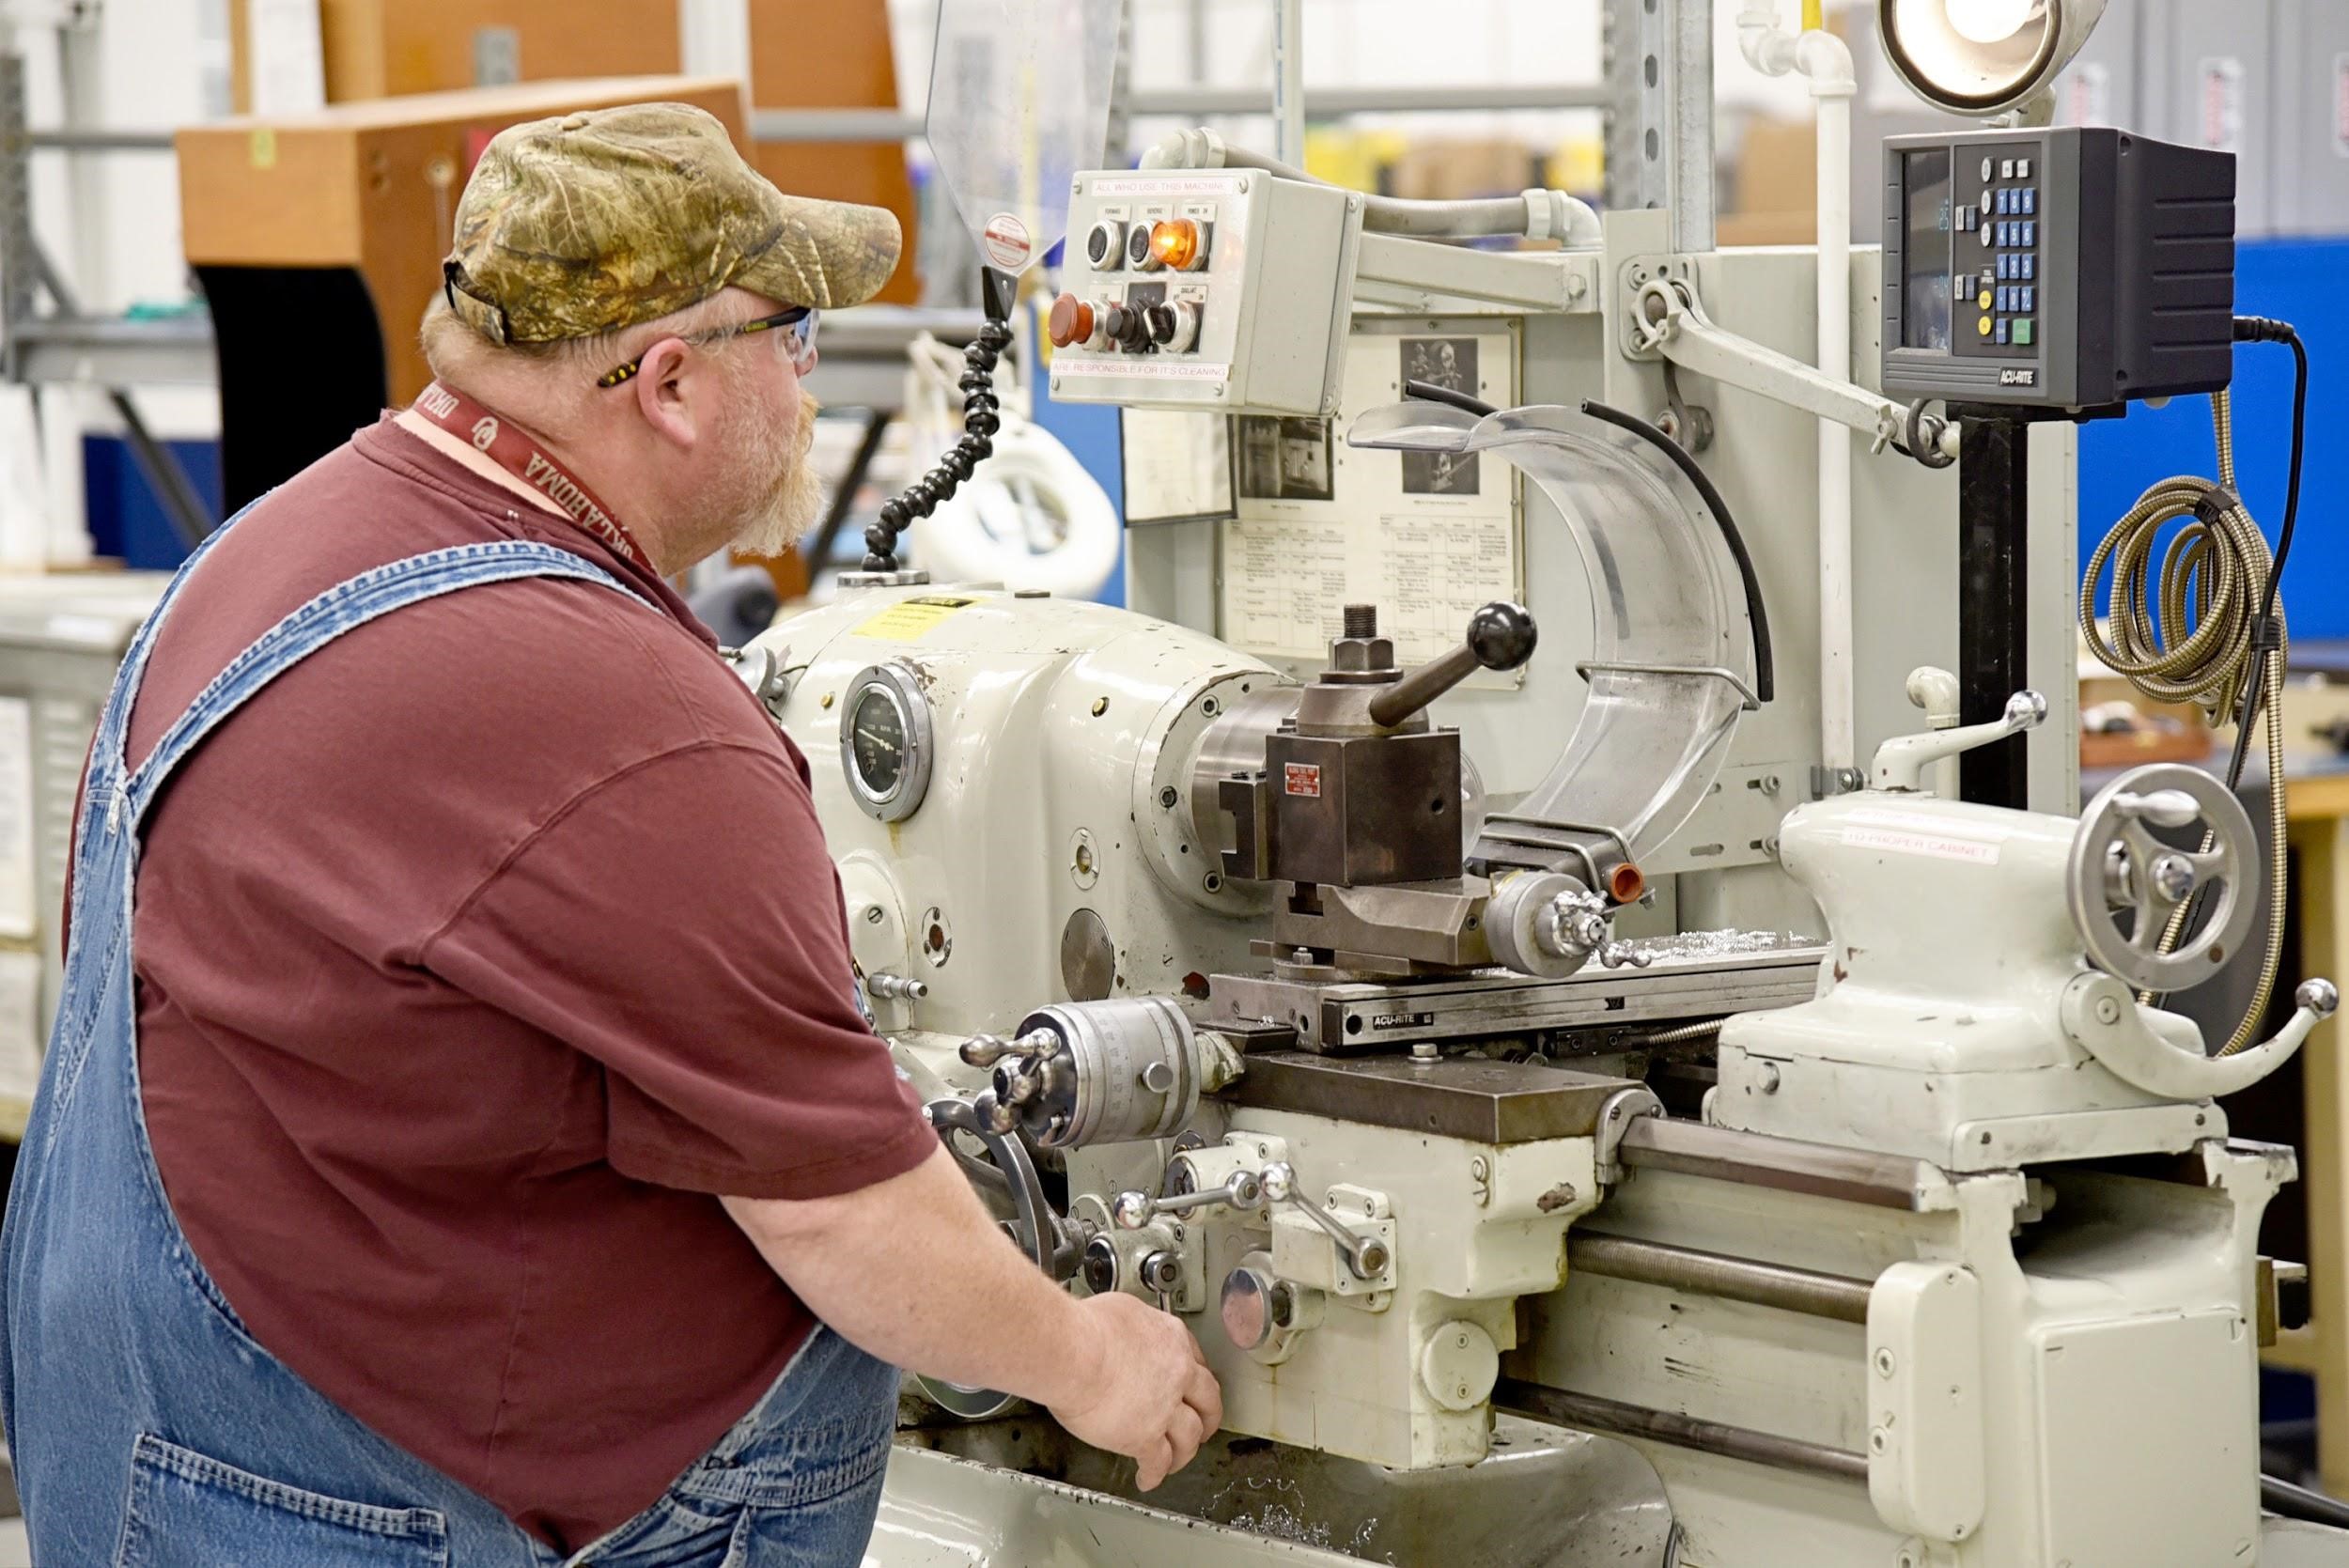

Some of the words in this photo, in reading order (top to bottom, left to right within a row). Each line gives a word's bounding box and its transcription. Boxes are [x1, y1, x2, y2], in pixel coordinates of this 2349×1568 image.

[1097, 183, 1112, 192] ALL
[1114, 183, 1136, 192] WHO
[1139, 182, 1157, 191] USE
[1160, 182, 1182, 191] THIS
[1999, 195, 2004, 209] 7
[2012, 195, 2017, 210] 8
[2024, 195, 2030, 209] 9
[1999, 228, 2004, 241] 4
[2012, 228, 2017, 241] 5
[2024, 228, 2030, 241] 6
[2012, 260, 2017, 273] 2
[2024, 260, 2030, 273] 3
[2011, 292, 2016, 305] 0
[1052, 363, 1068, 371] ARE
[1073, 363, 1136, 374] RESPONSIBLE
[1138, 365, 1158, 374] FOR
[1178, 366, 1226, 377] CLEANING
[2000, 370, 2033, 384] ACU-RITE
[1375, 1015, 1415, 1026] ACU-RITE
